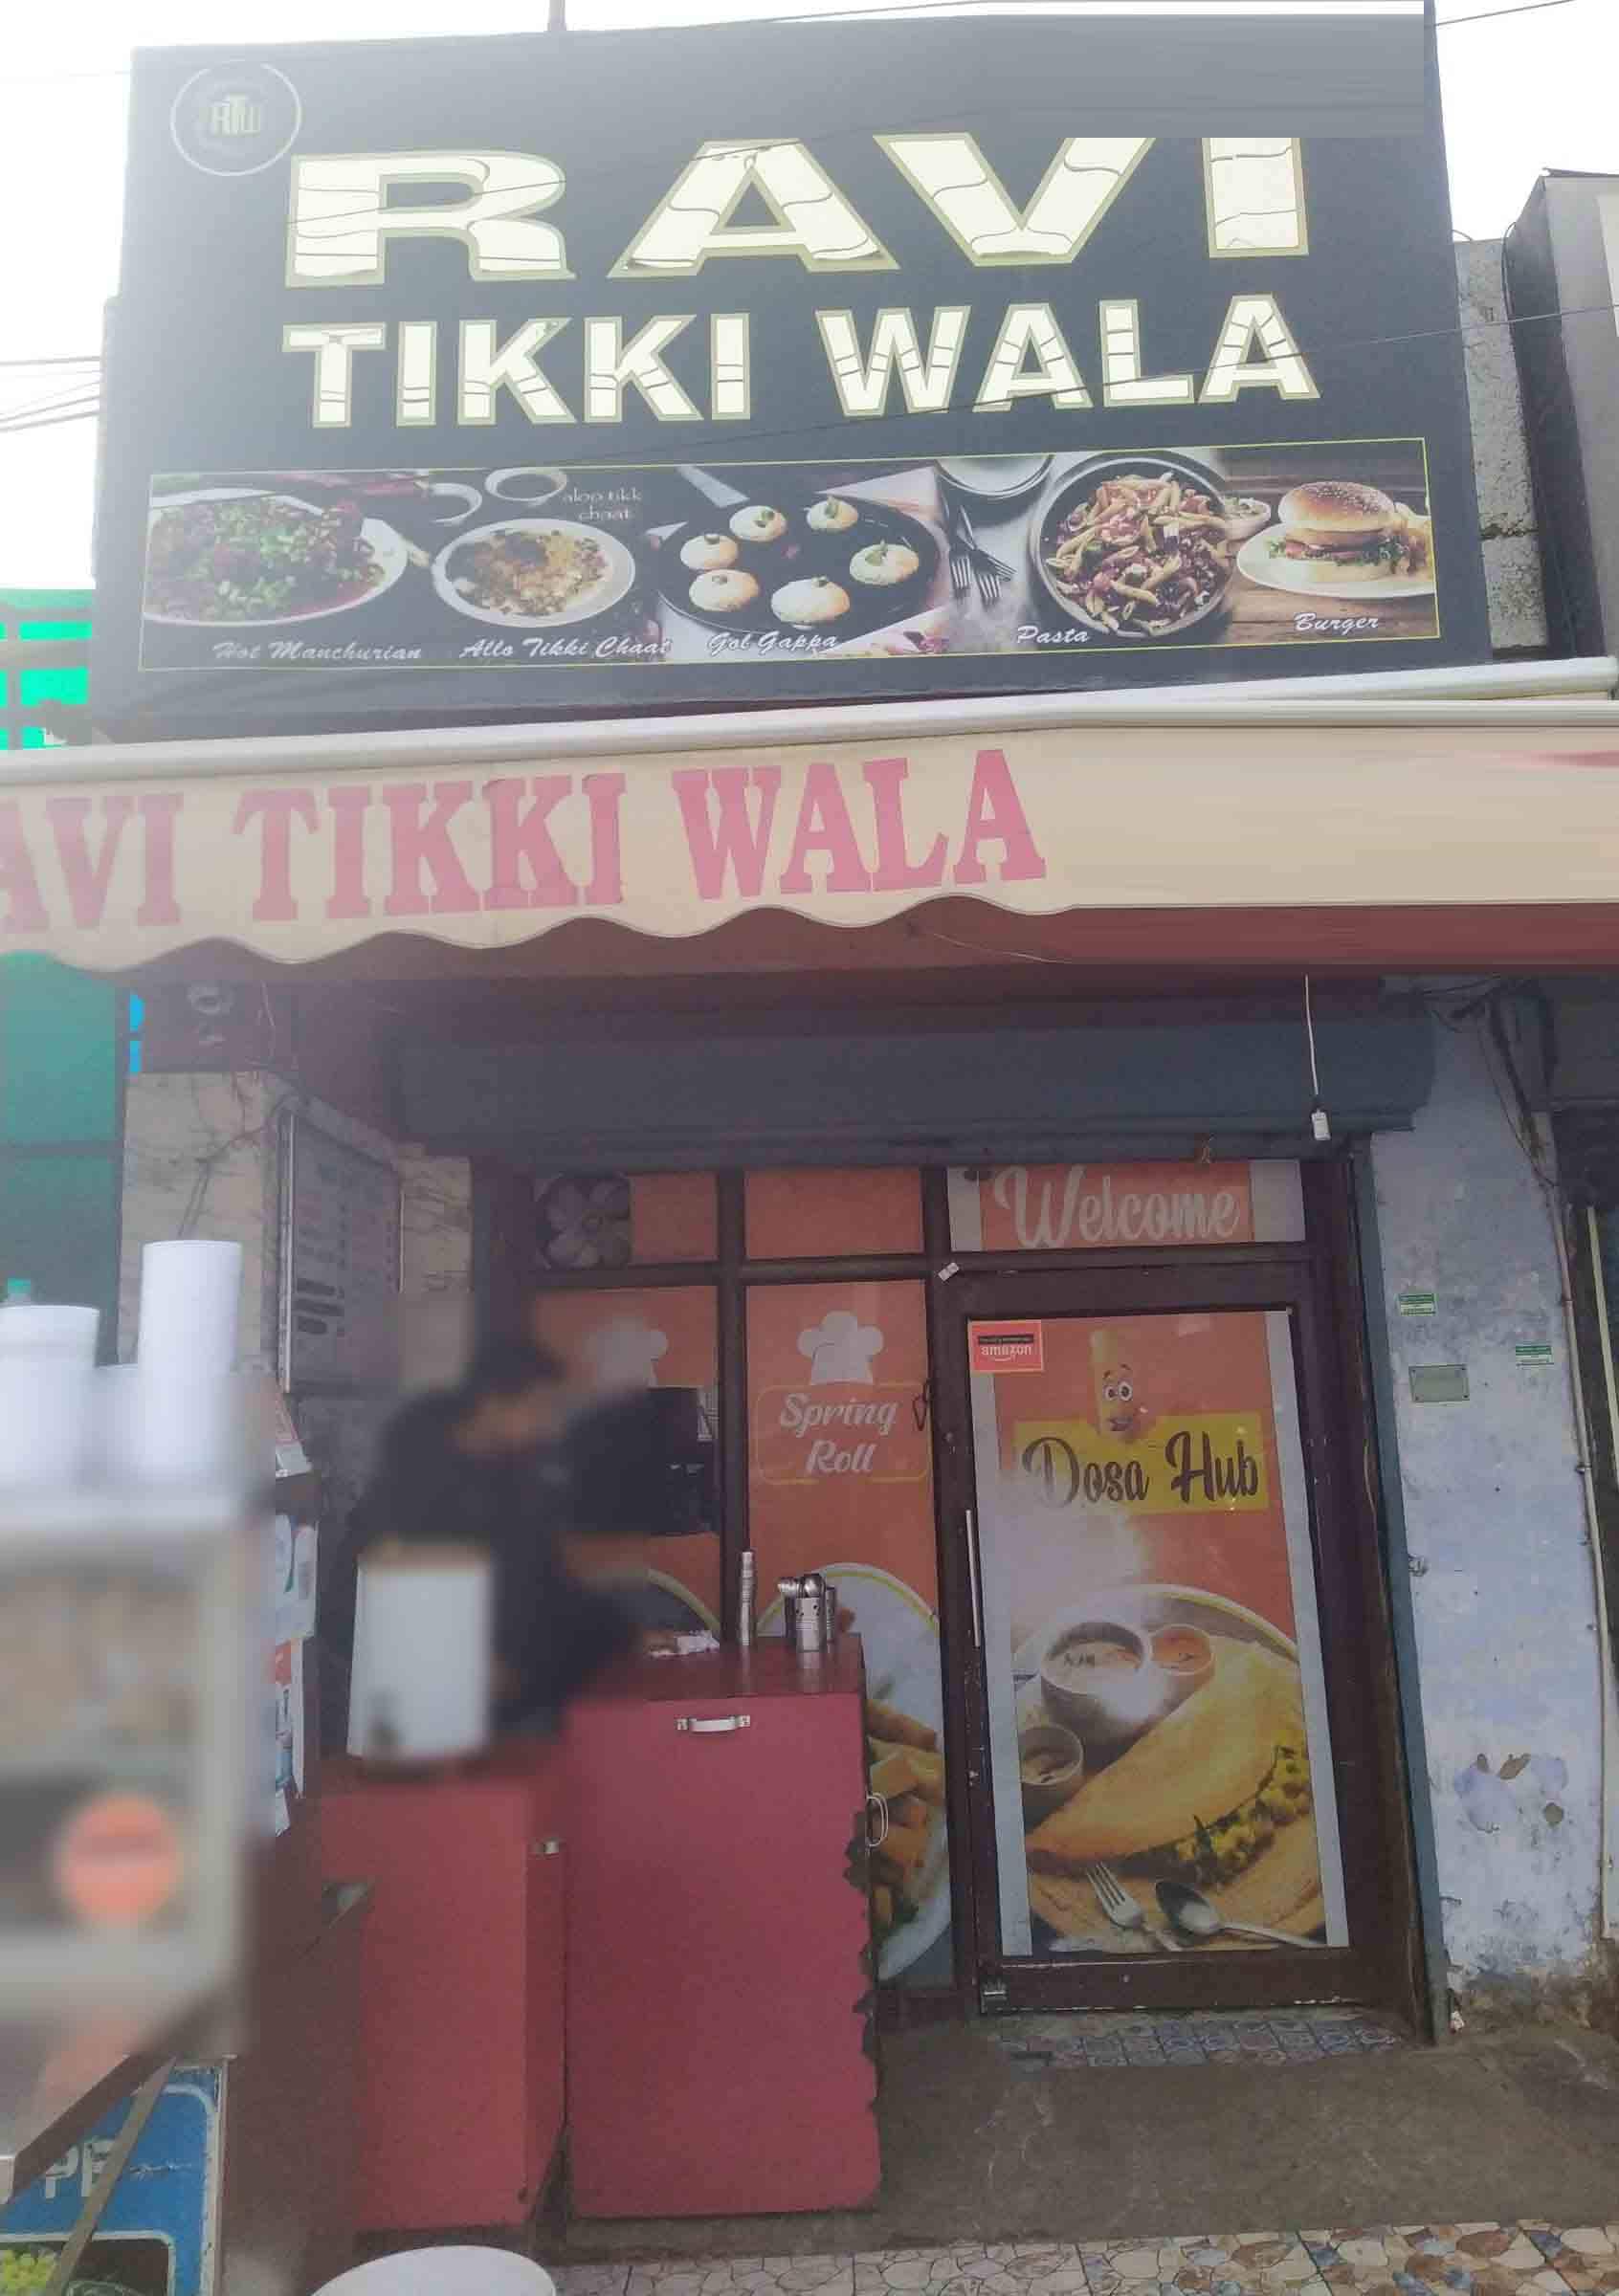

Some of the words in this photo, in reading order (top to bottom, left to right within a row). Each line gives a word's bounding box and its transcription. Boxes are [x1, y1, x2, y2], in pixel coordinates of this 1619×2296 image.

[286, 132, 1309, 288] RAVI
[282, 312, 751, 428] TIKKI
[815, 294, 1320, 416] WALA
[758, 630, 838, 655] Gappa
[1016, 625, 1089, 644] Pasta
[1294, 612, 1379, 636] Burger
[211, 640, 261, 660] Hot
[268, 639, 422, 660] Manchurian
[459, 638, 514, 658] Allo
[521, 637, 588, 658] Tikki
[594, 635, 672, 658] Chaat
[233, 773, 625, 921] TIKKI
[673, 749, 1047, 901] WALA
[994, 1163, 1241, 1248] Welcome
[980, 1345, 1032, 1356] amazon
[779, 1393, 900, 1438] Spring
[805, 1439, 877, 1476] Roll
[1021, 1436, 1150, 1509] Dosa
[1164, 1431, 1259, 1503] Hub
